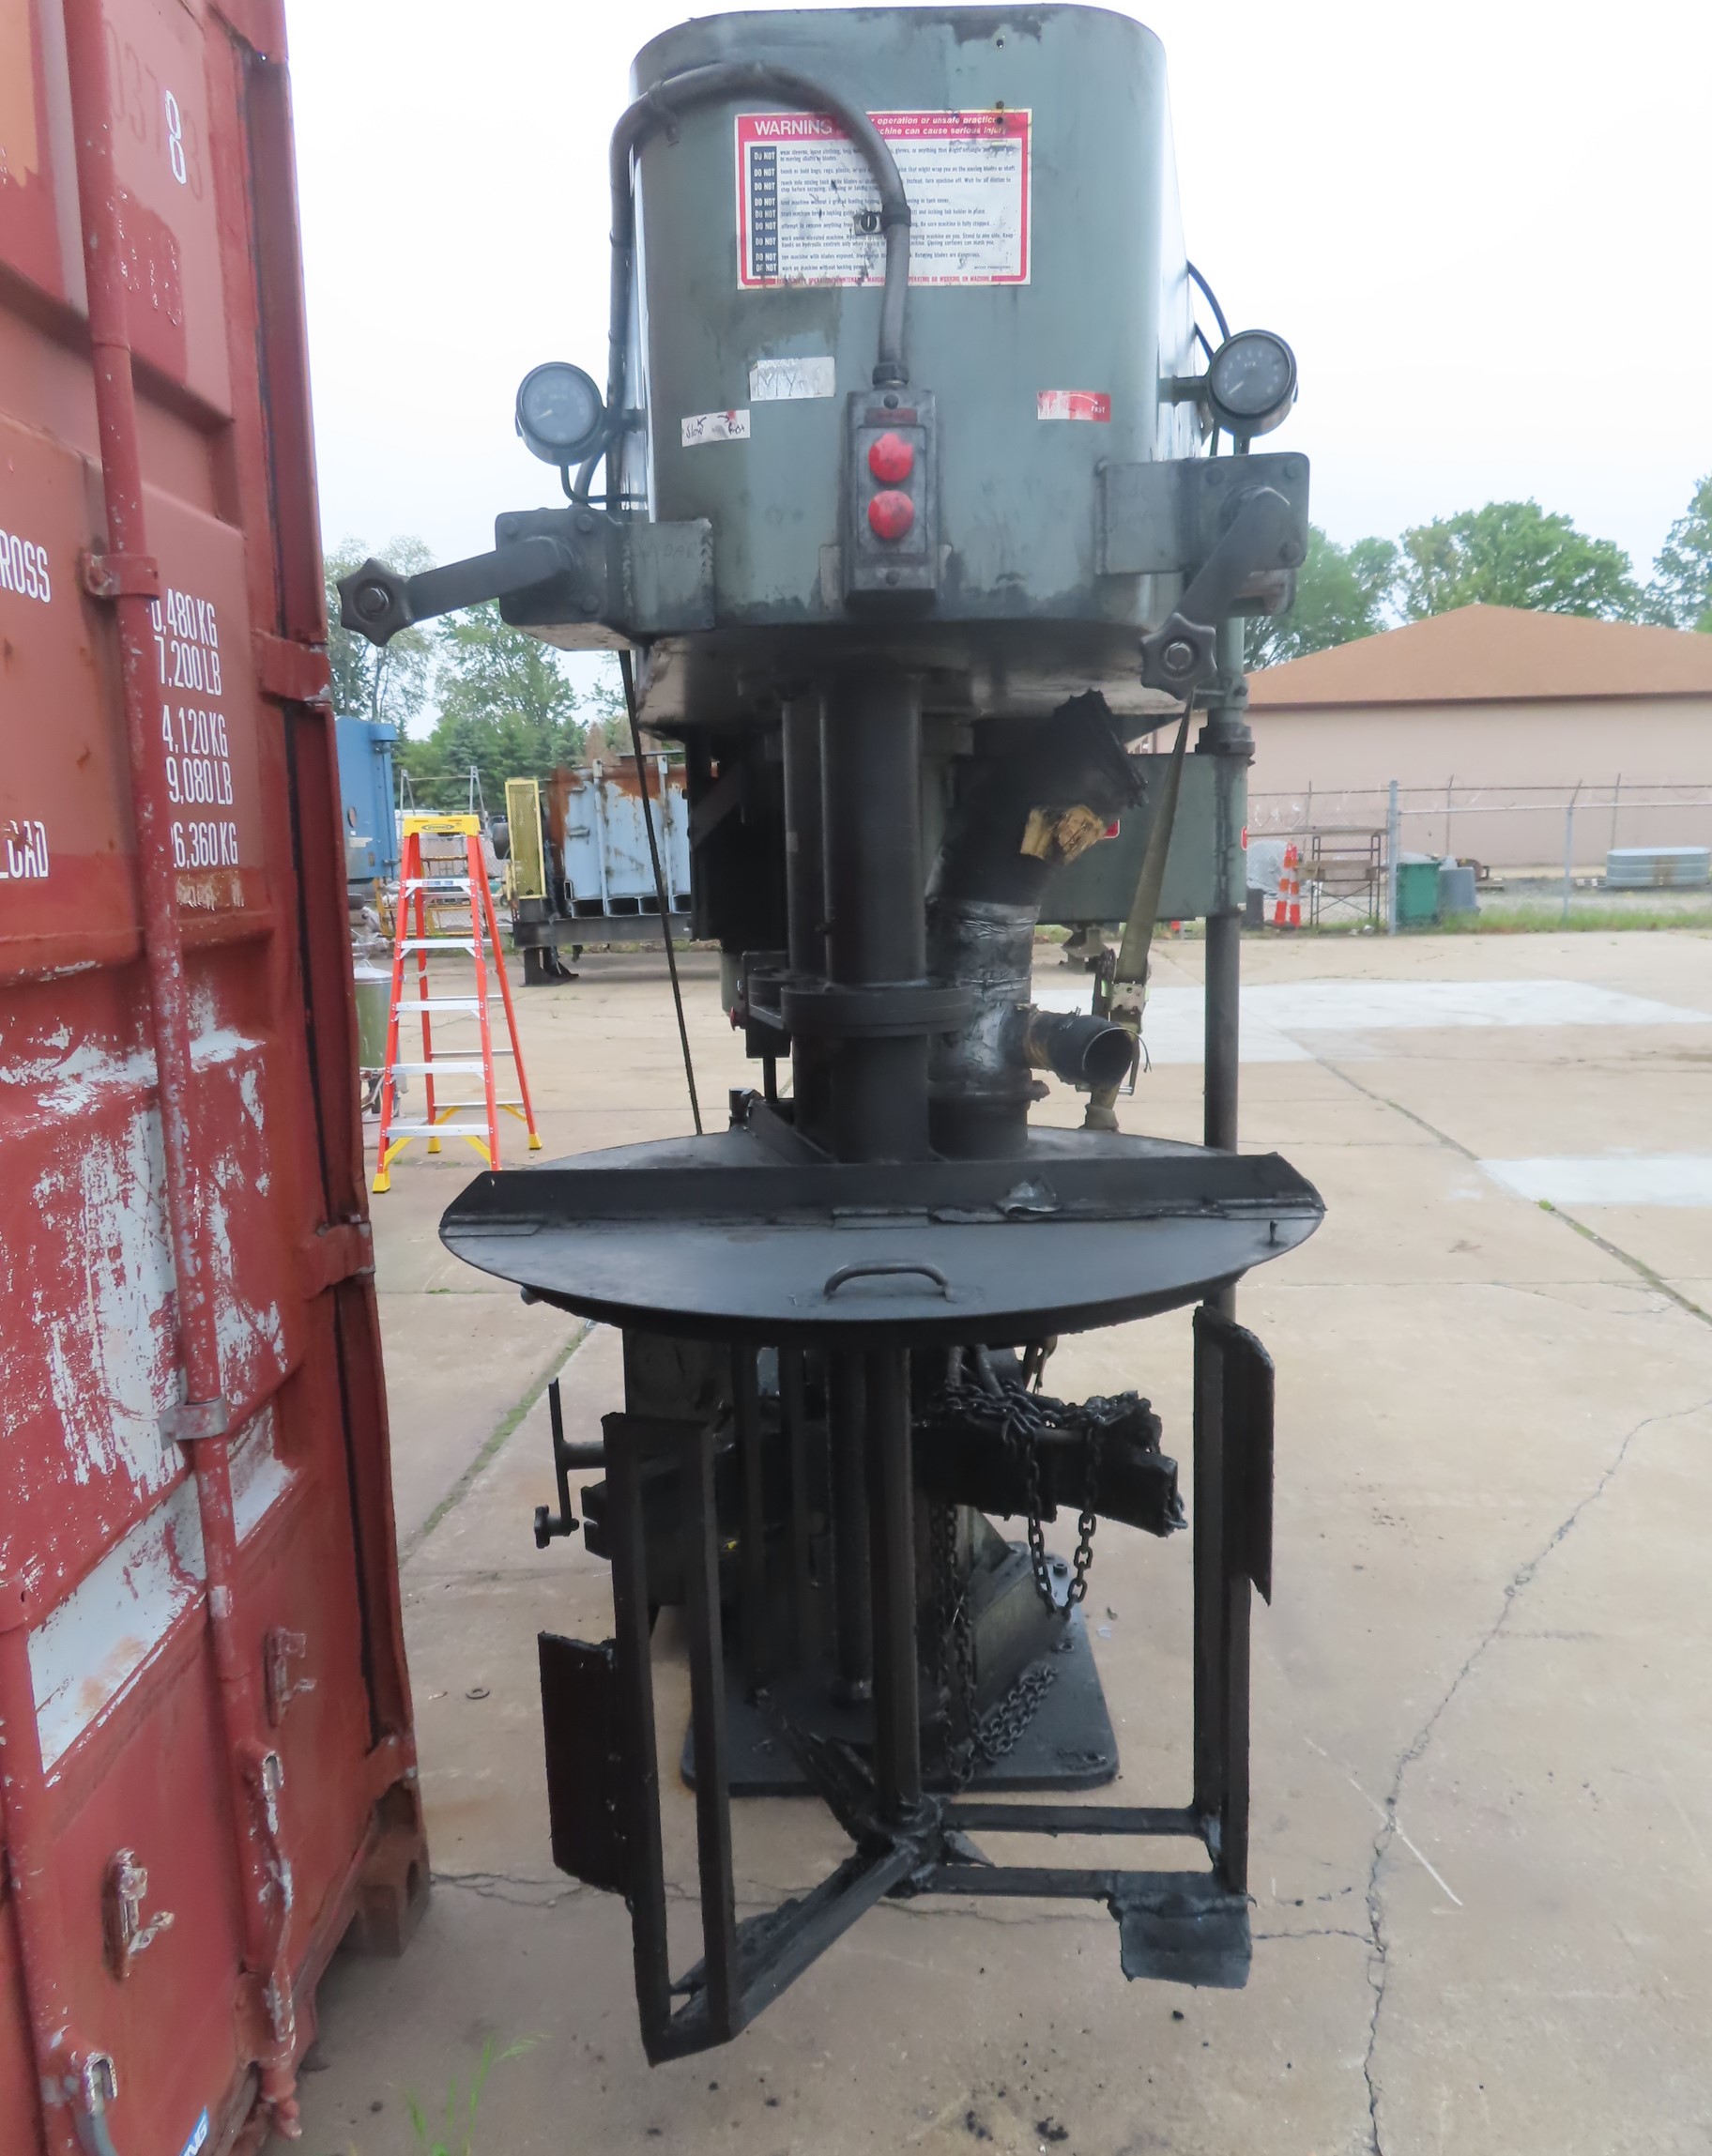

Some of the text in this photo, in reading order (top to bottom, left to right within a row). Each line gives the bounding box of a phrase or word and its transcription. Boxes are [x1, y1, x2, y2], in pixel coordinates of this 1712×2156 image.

[878, 116, 918, 125] operation
[933, 116, 960, 125] unsafe
[755, 119, 833, 135] WARNING
[754, 152, 762, 161] DO
[764, 182, 775, 191] NOT
[765, 222, 776, 230] NOT
